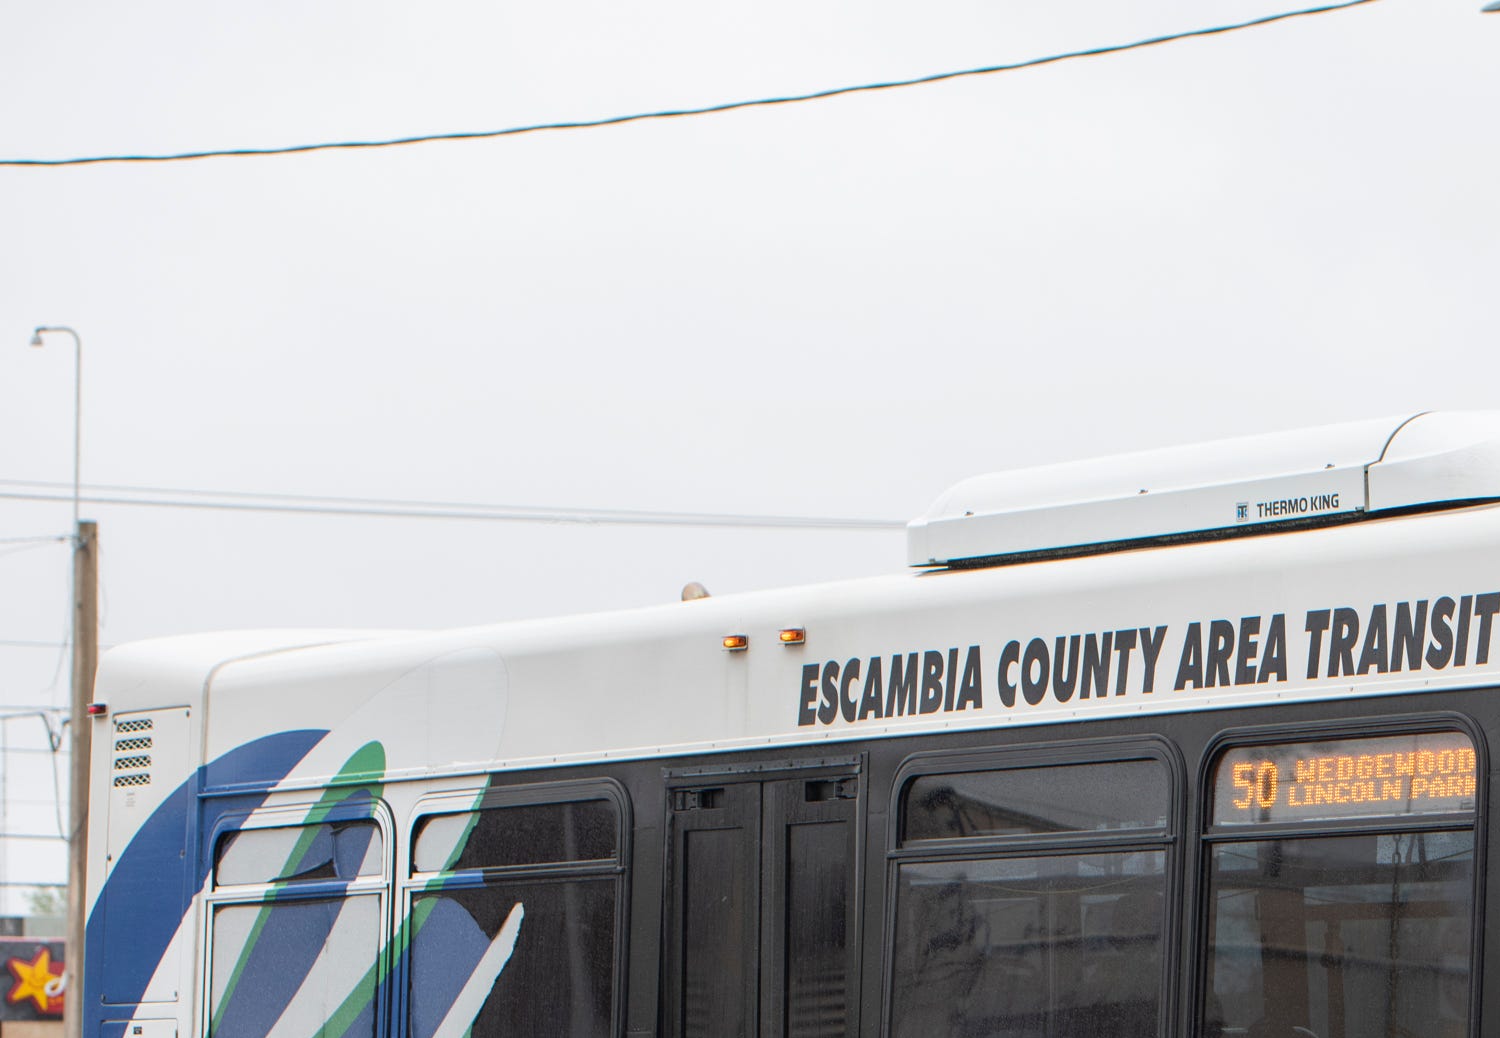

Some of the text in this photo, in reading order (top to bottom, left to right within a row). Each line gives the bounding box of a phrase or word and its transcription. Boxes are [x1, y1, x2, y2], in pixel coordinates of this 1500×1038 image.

[1256, 497, 1308, 518] THERMO
[1310, 493, 1339, 511] KING
[798, 644, 983, 727] ESCAMBIA
[997, 624, 1169, 708] COUNTY
[1173, 612, 1288, 692] AREA
[1231, 748, 1476, 809] 50 WEDGEWOOD
[1288, 779, 1402, 806] LINCOLN
